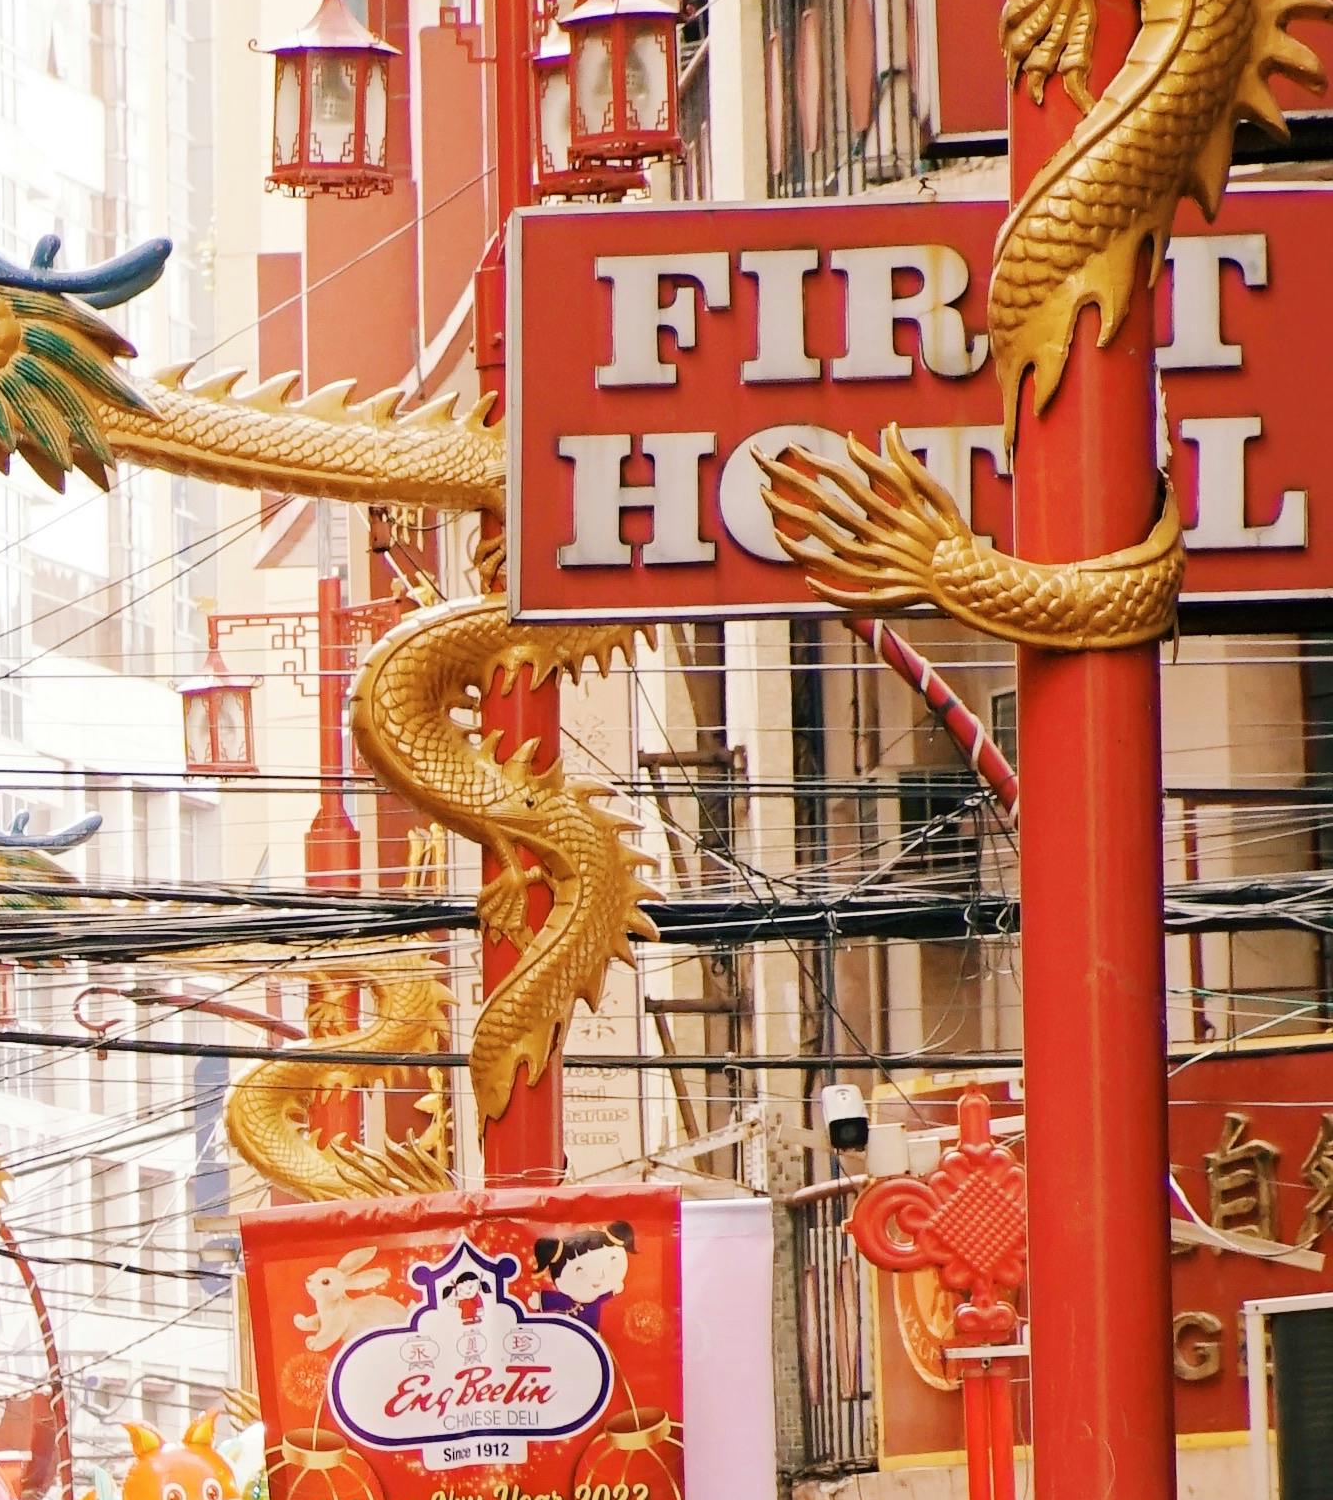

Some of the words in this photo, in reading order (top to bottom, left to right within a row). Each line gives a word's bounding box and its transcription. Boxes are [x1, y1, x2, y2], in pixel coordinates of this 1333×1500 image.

[594, 232, 1269, 390] FIRT
[556, 415, 1308, 568] HOTL
[384, 1374, 453, 1418] Eng
[507, 1410, 539, 1426] DELI
[443, 1447, 471, 1462] Since
[476, 1442, 510, 1457] 1912
